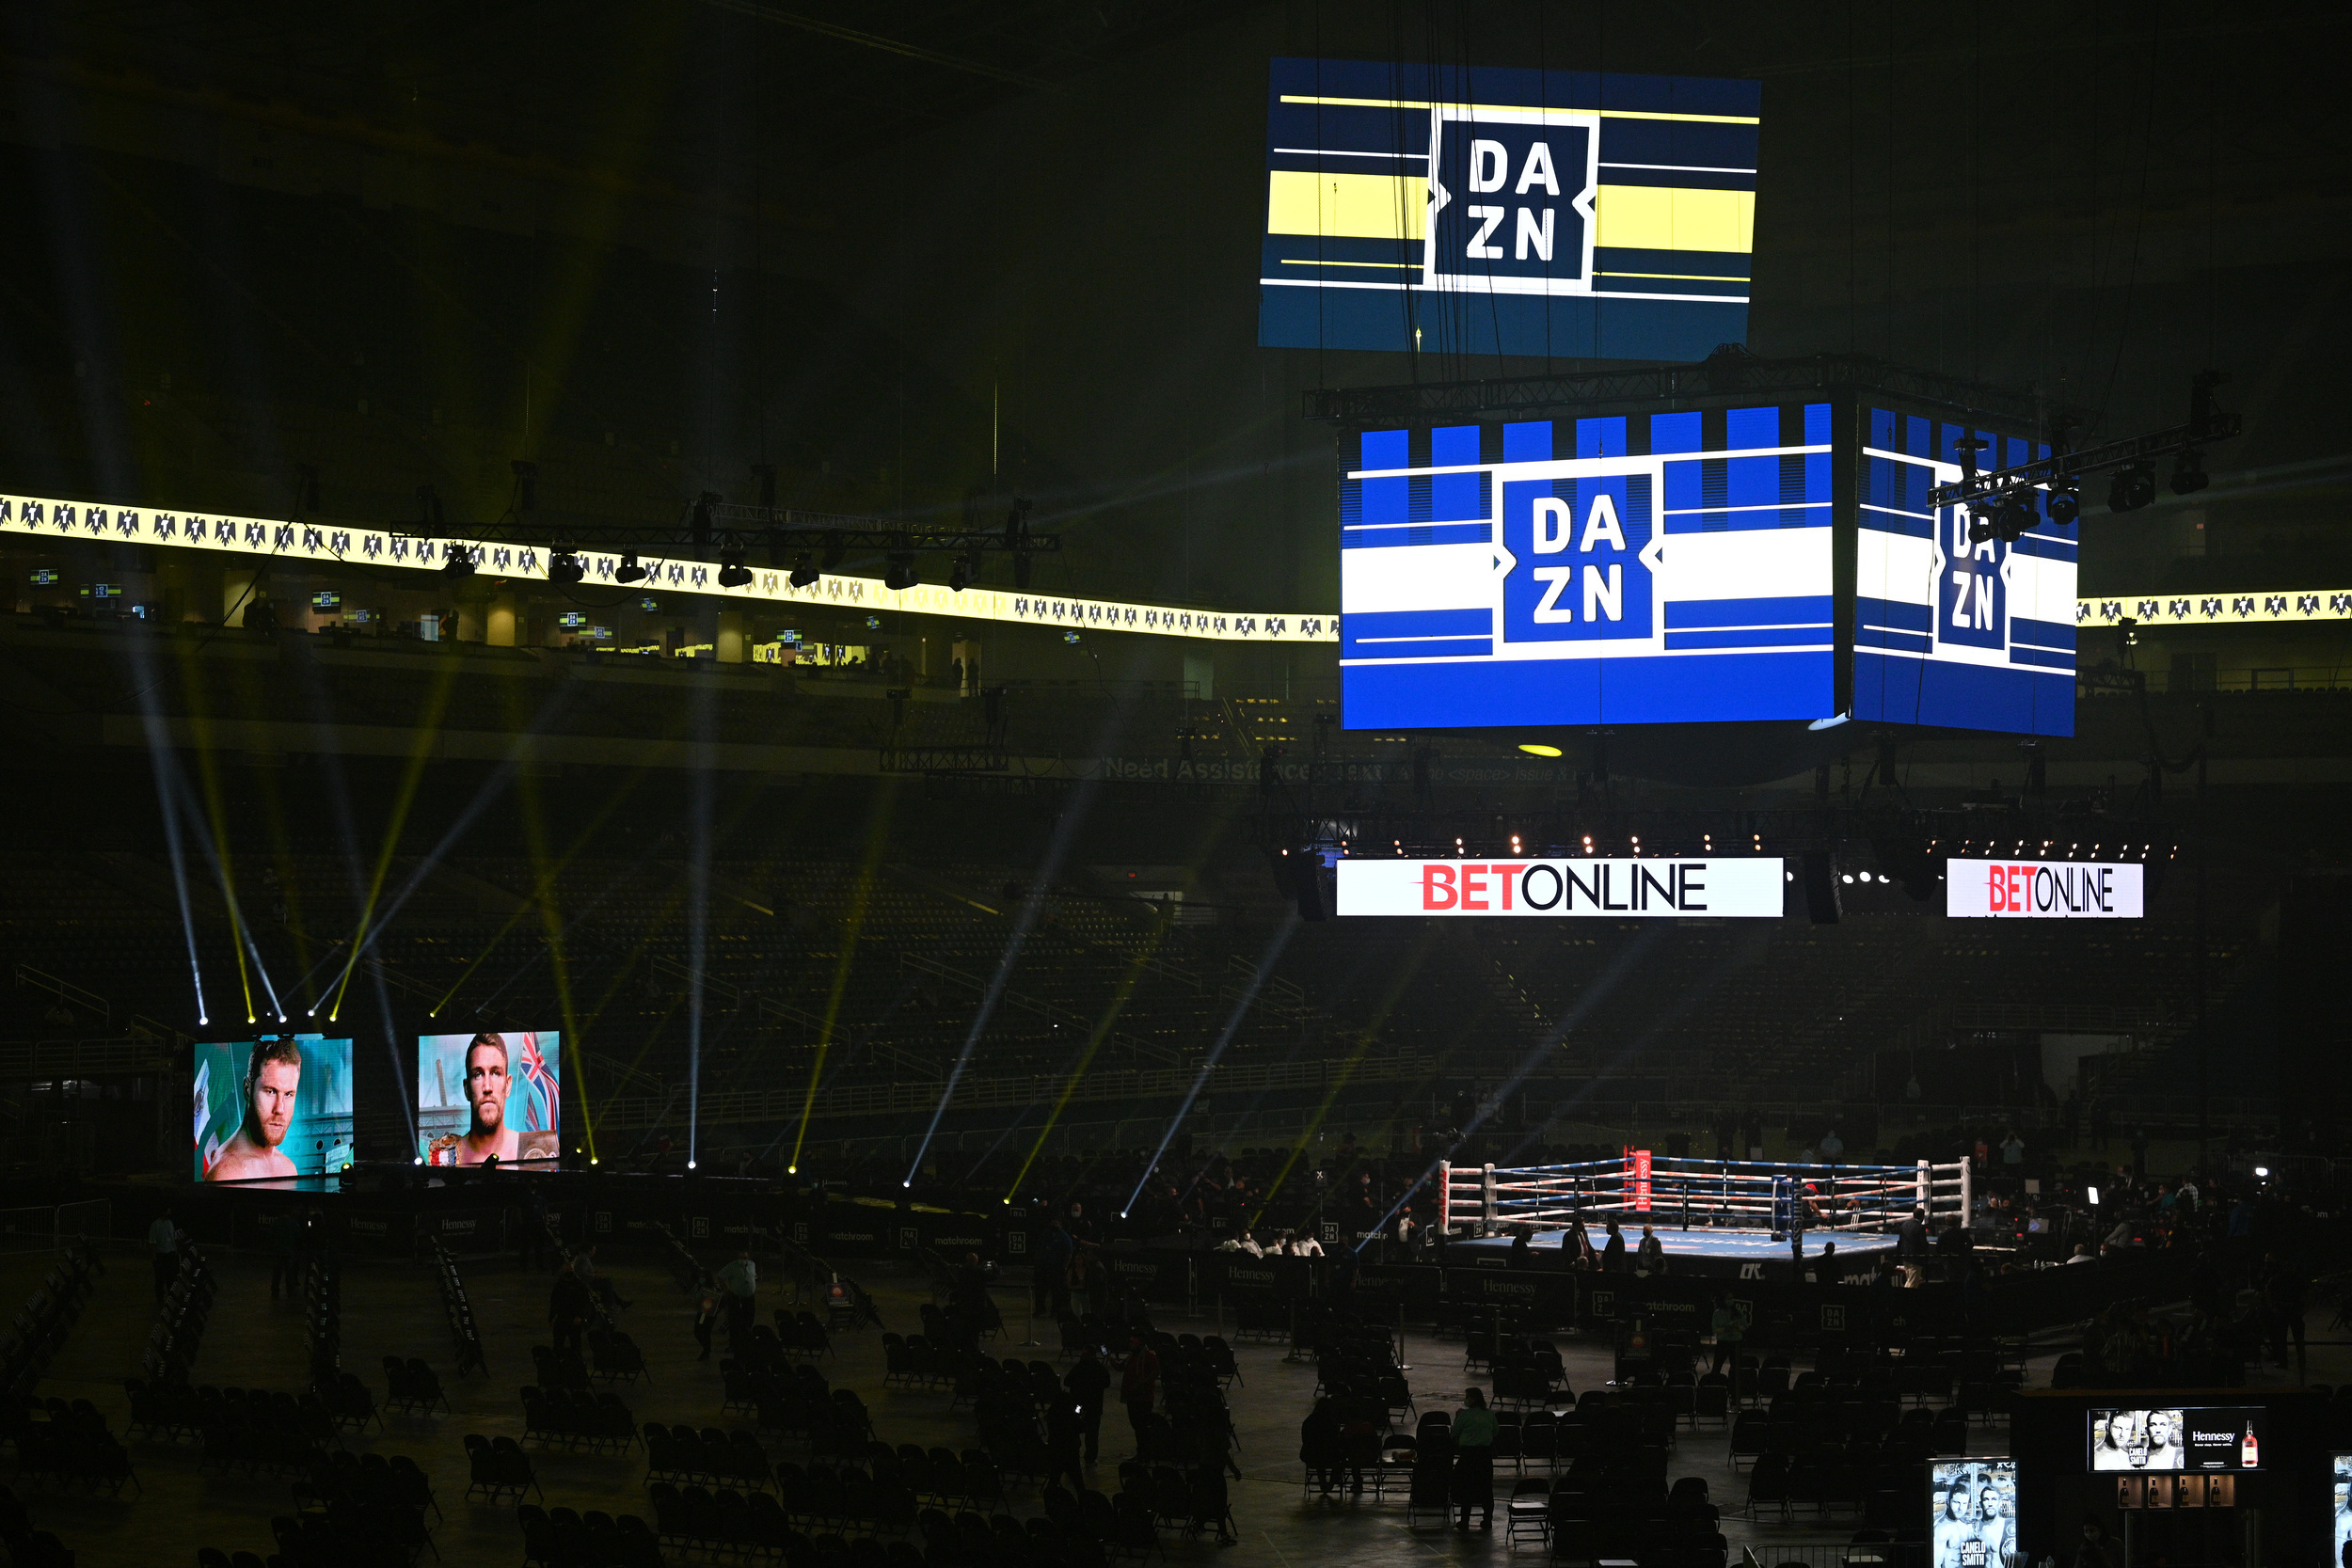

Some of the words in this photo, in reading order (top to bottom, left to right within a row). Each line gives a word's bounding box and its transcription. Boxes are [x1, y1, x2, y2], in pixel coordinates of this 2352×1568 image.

[1469, 139, 1560, 195] DA
[1466, 205, 1556, 261] ZN
[1533, 494, 1627, 554] DA
[1533, 564, 1623, 624] ZN
[1952, 570, 1994, 631] ZN
[1105, 756, 1168, 779] Need
[1420, 863, 1708, 911] BETONLINE
[1987, 864, 2113, 912] BETONLINE
[442, 1219, 477, 1231] Hennessy
[935, 1236, 982, 1245] matchroom
[1114, 1259, 1158, 1275] Hennessy
[1229, 1265, 1275, 1281] Hennessy
[1484, 1279, 1537, 1296] Hennessy
[2192, 1431, 2234, 1443] Hennessy
[1961, 1541, 1986, 1554] CANELO
[1962, 1554, 1985, 1566] SMITH
